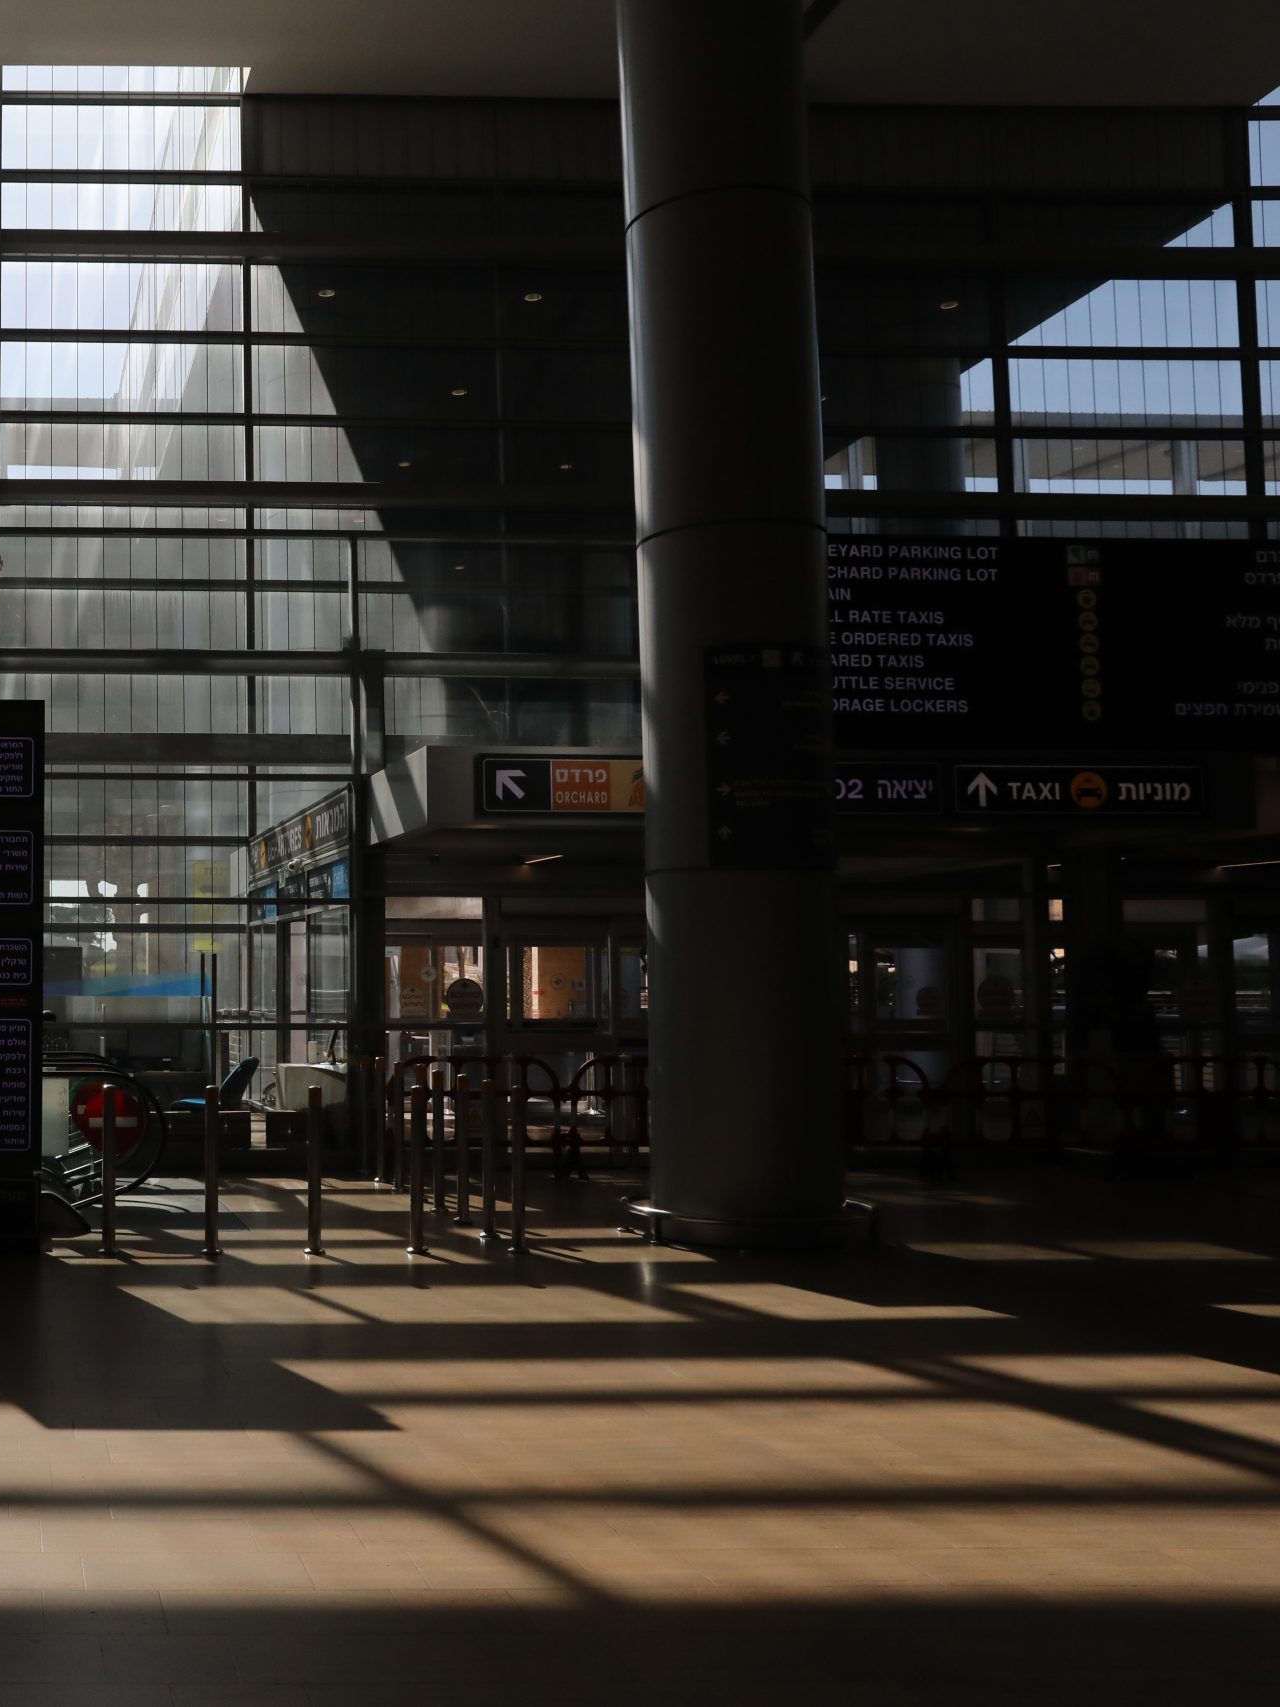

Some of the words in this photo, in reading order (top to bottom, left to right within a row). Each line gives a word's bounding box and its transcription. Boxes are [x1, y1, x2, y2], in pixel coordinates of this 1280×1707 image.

[888, 546, 961, 559] PARKING
[967, 547, 999, 560] LOT
[888, 568, 961, 581] PARKING
[967, 569, 999, 582] LOT
[849, 610, 892, 623] RATE
[896, 611, 945, 624] TAXIS
[1225, 613, 1261, 629] מלא
[841, 632, 921, 646] ORDERED
[926, 633, 974, 647] TAXIS
[877, 654, 925, 668] TAXIS
[884, 677, 955, 691] SERVICE
[1237, 681, 1280, 695] פנימי
[890, 699, 969, 713] LOCKERS
[1175, 703, 1228, 717] חפצים
[556, 768, 607, 783] פרדס
[877, 779, 933, 799] יציאה
[1007, 781, 1061, 801] TAXI
[1117, 780, 1192, 801] מוניות
[556, 791, 608, 804] ORCHARD
[315, 803, 346, 840] המראות
